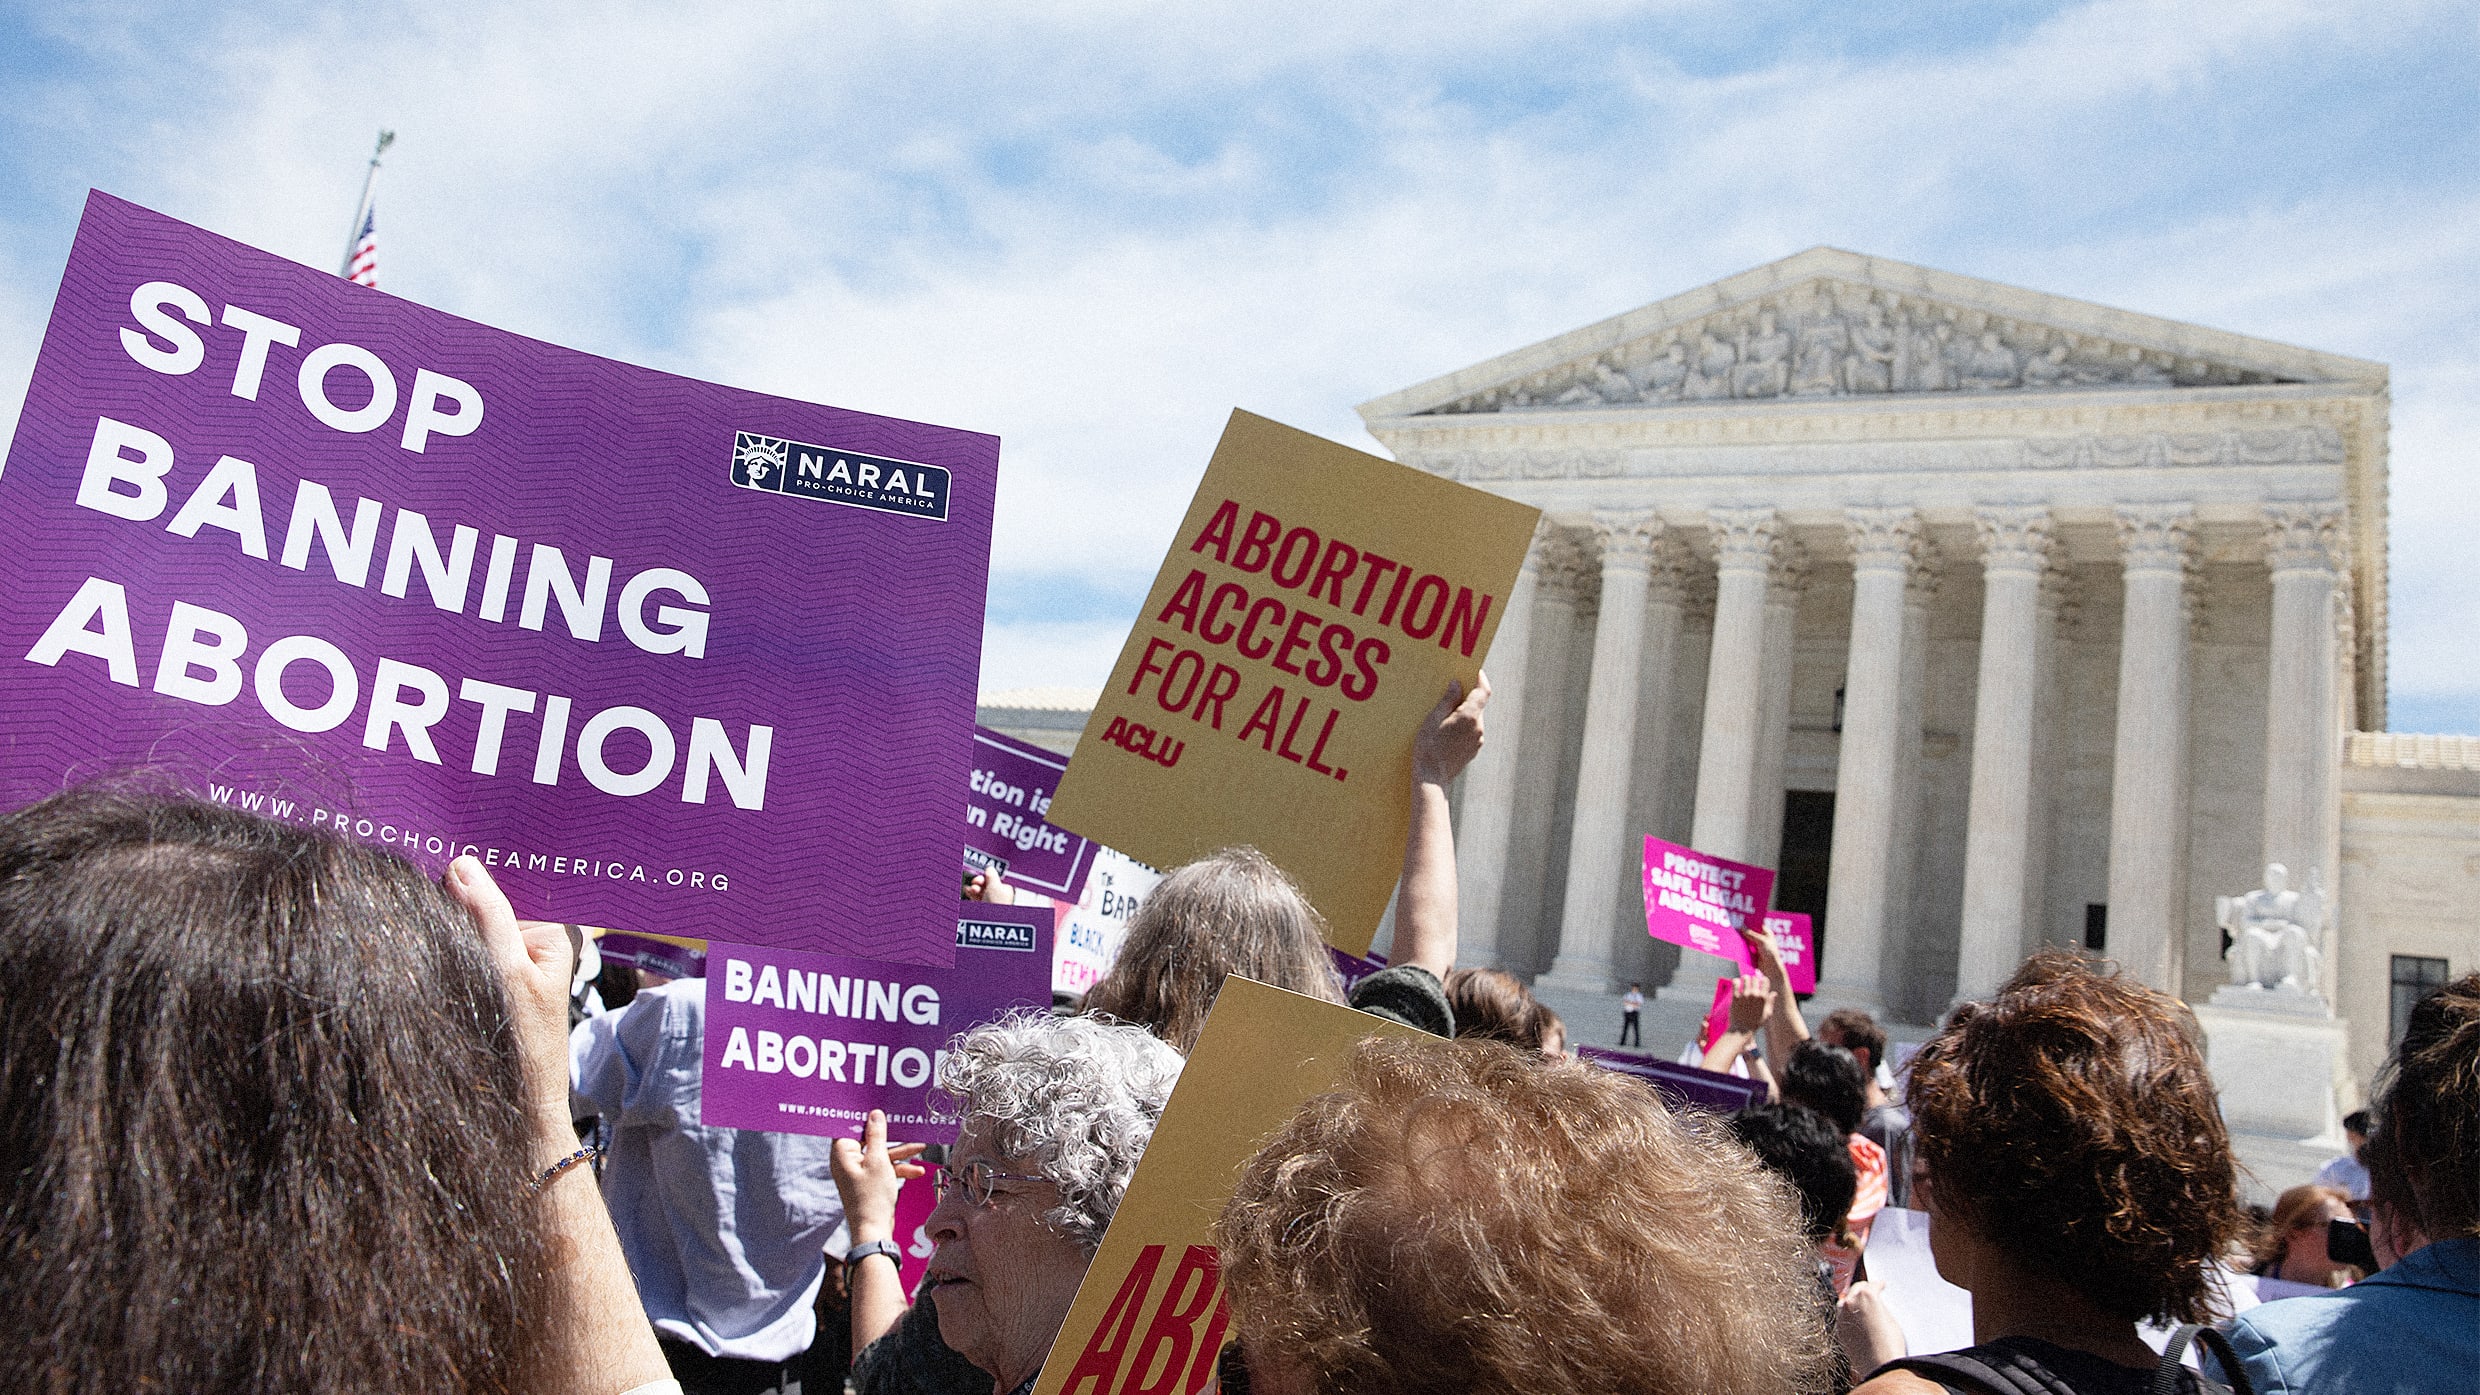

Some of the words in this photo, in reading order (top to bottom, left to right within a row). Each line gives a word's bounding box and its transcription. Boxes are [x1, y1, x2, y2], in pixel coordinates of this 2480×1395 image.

[119, 281, 485, 454] STOP
[796, 480, 874, 499] PRO-CHOICE
[880, 493, 935, 509] AMERICA
[798, 452, 935, 498] NARAL
[75, 416, 711, 659] BANNING
[1190, 499, 1492, 657] ABORTION
[1157, 569, 1390, 702] ACCESS
[24, 576, 773, 810] ABORTION
[1127, 637, 1241, 730] FOR
[1237, 686, 1348, 781] ALL.
[1101, 716, 1185, 767] ACLU
[1029, 788, 1053, 816] is
[991, 812, 1068, 854] Right
[1651, 867, 1698, 900] SAFE,
[1699, 884, 1755, 914] LEGAL
[1664, 852, 1746, 890] PROTECT
[1658, 889, 1745, 928] ABORTION
[969, 925, 1029, 942] NARAL
[725, 959, 940, 1026] BANNING
